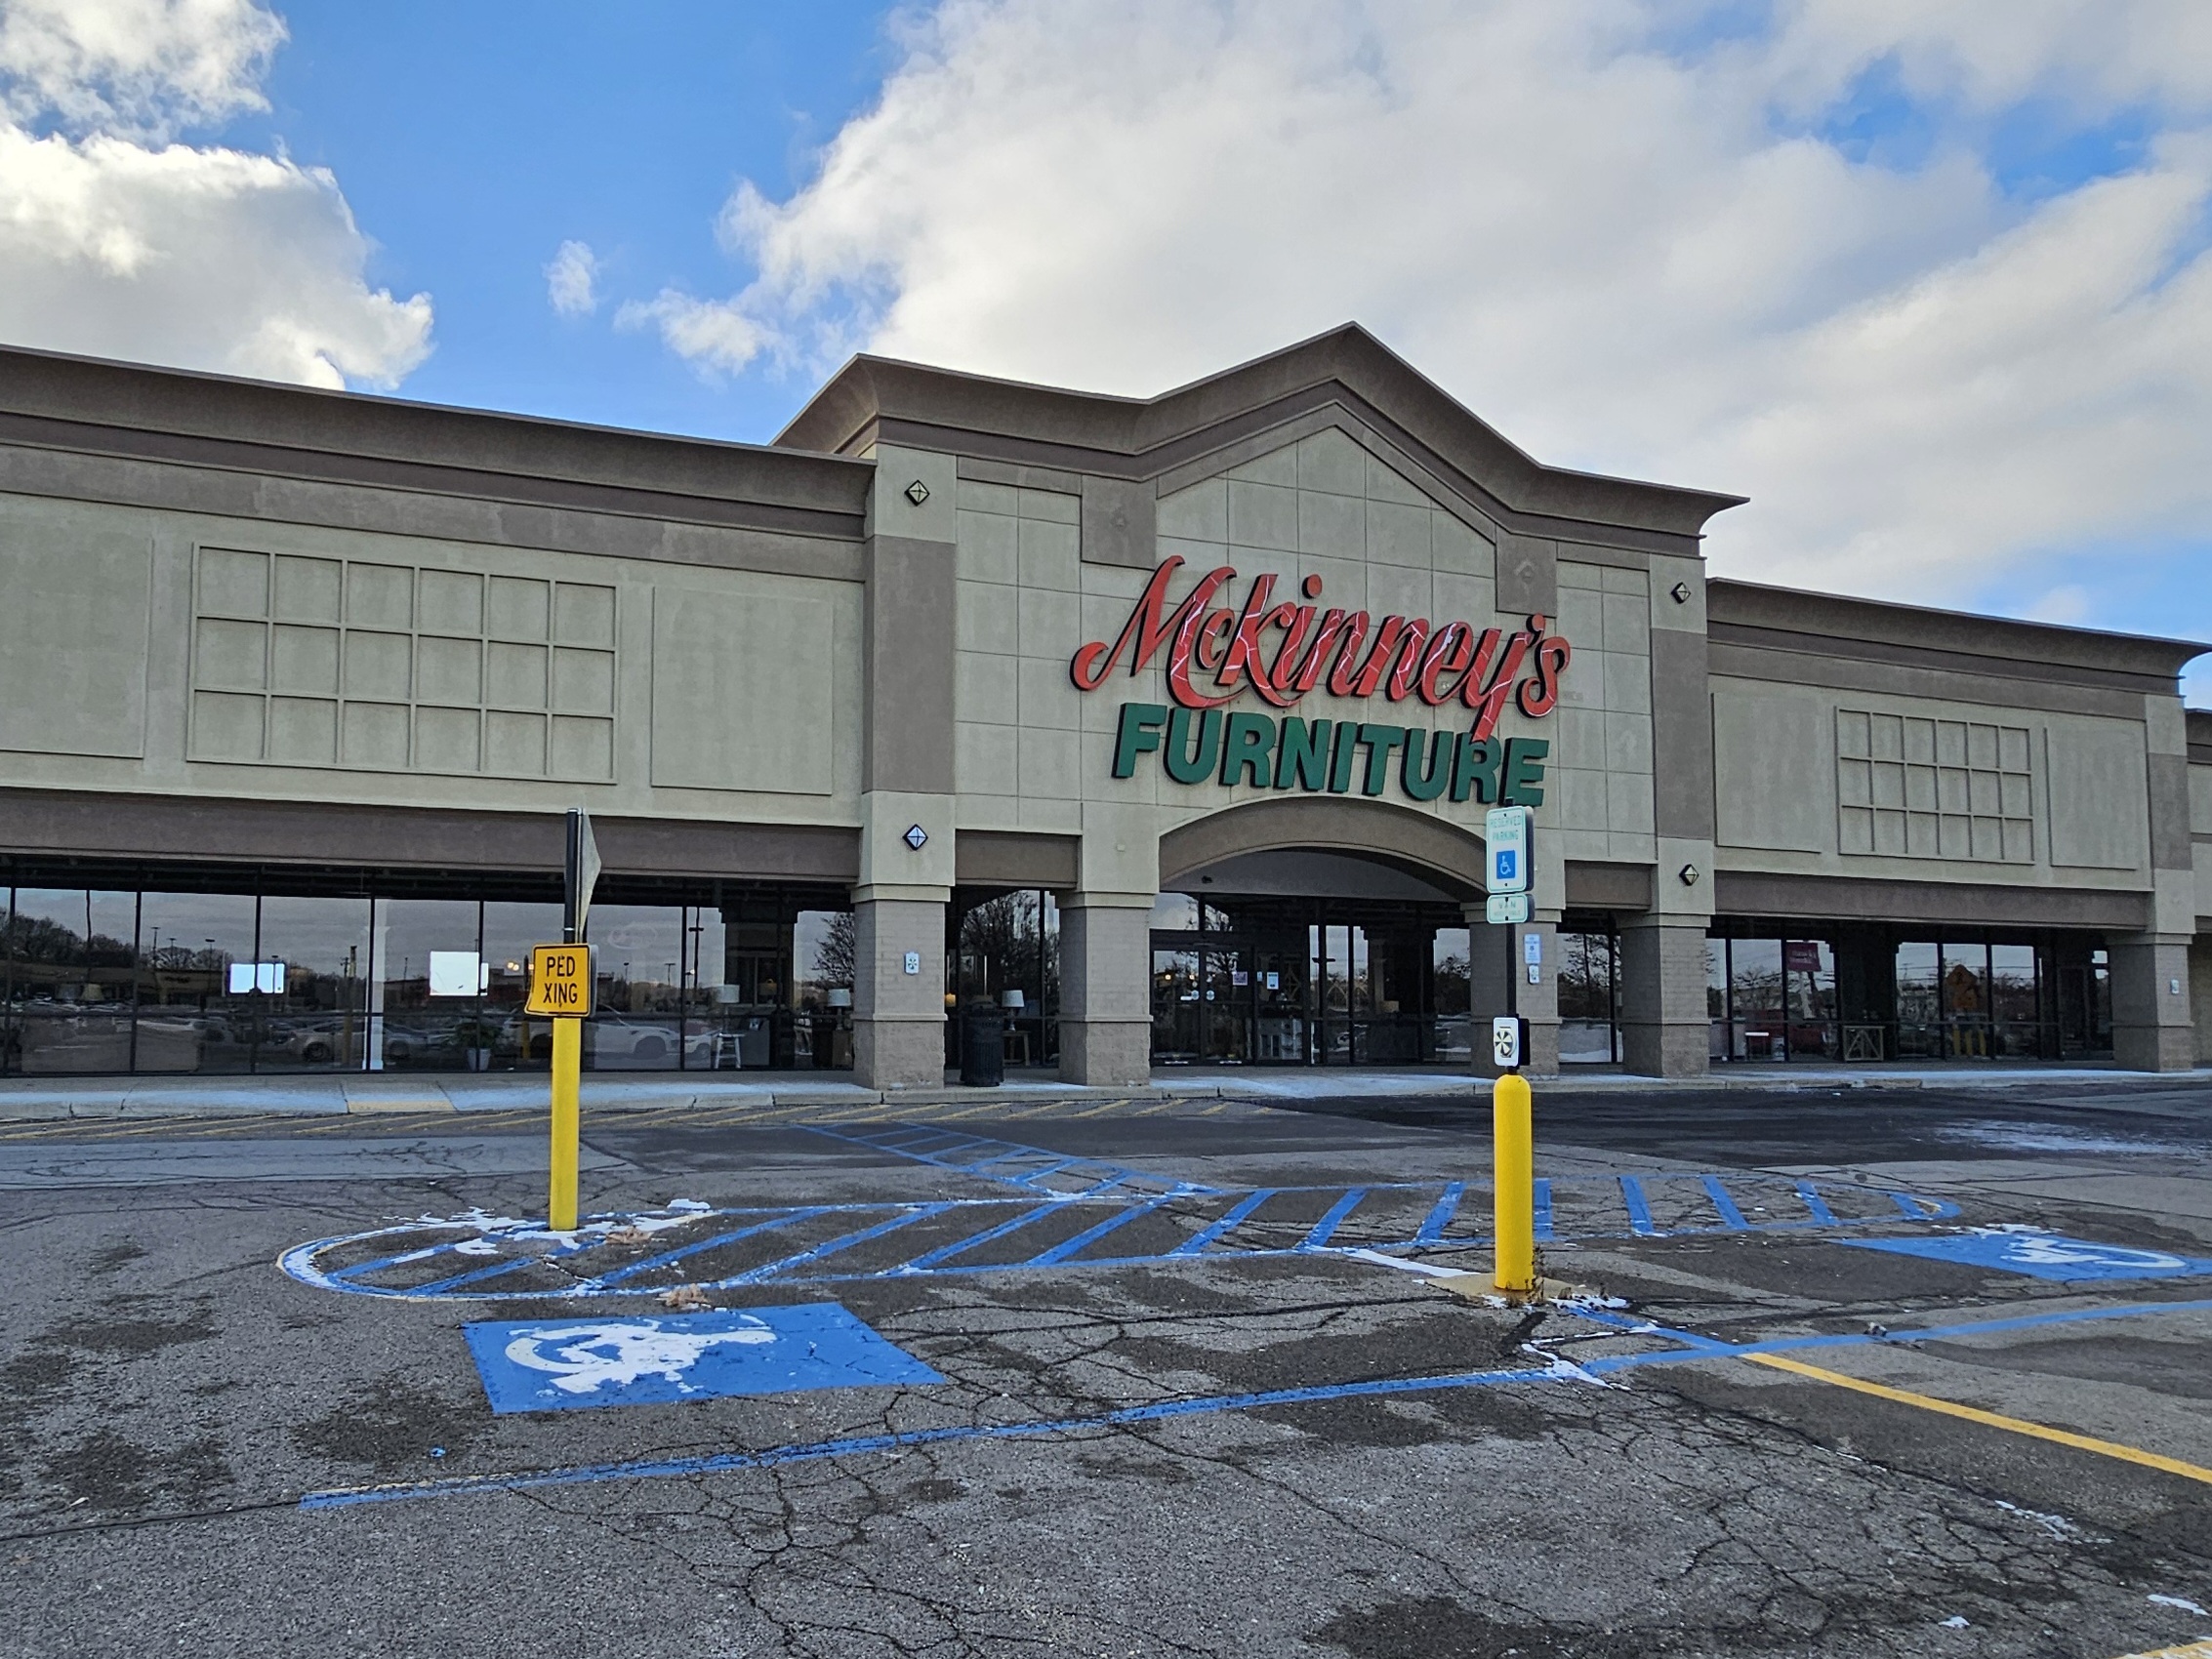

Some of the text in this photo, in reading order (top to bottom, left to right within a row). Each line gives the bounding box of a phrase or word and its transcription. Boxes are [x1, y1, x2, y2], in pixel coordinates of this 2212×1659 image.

[1112, 703, 1549, 806] FURNITURE
[1493, 829, 1519, 840] PARKING
[547, 955, 575, 977] PED
[543, 983, 578, 1004] XING
